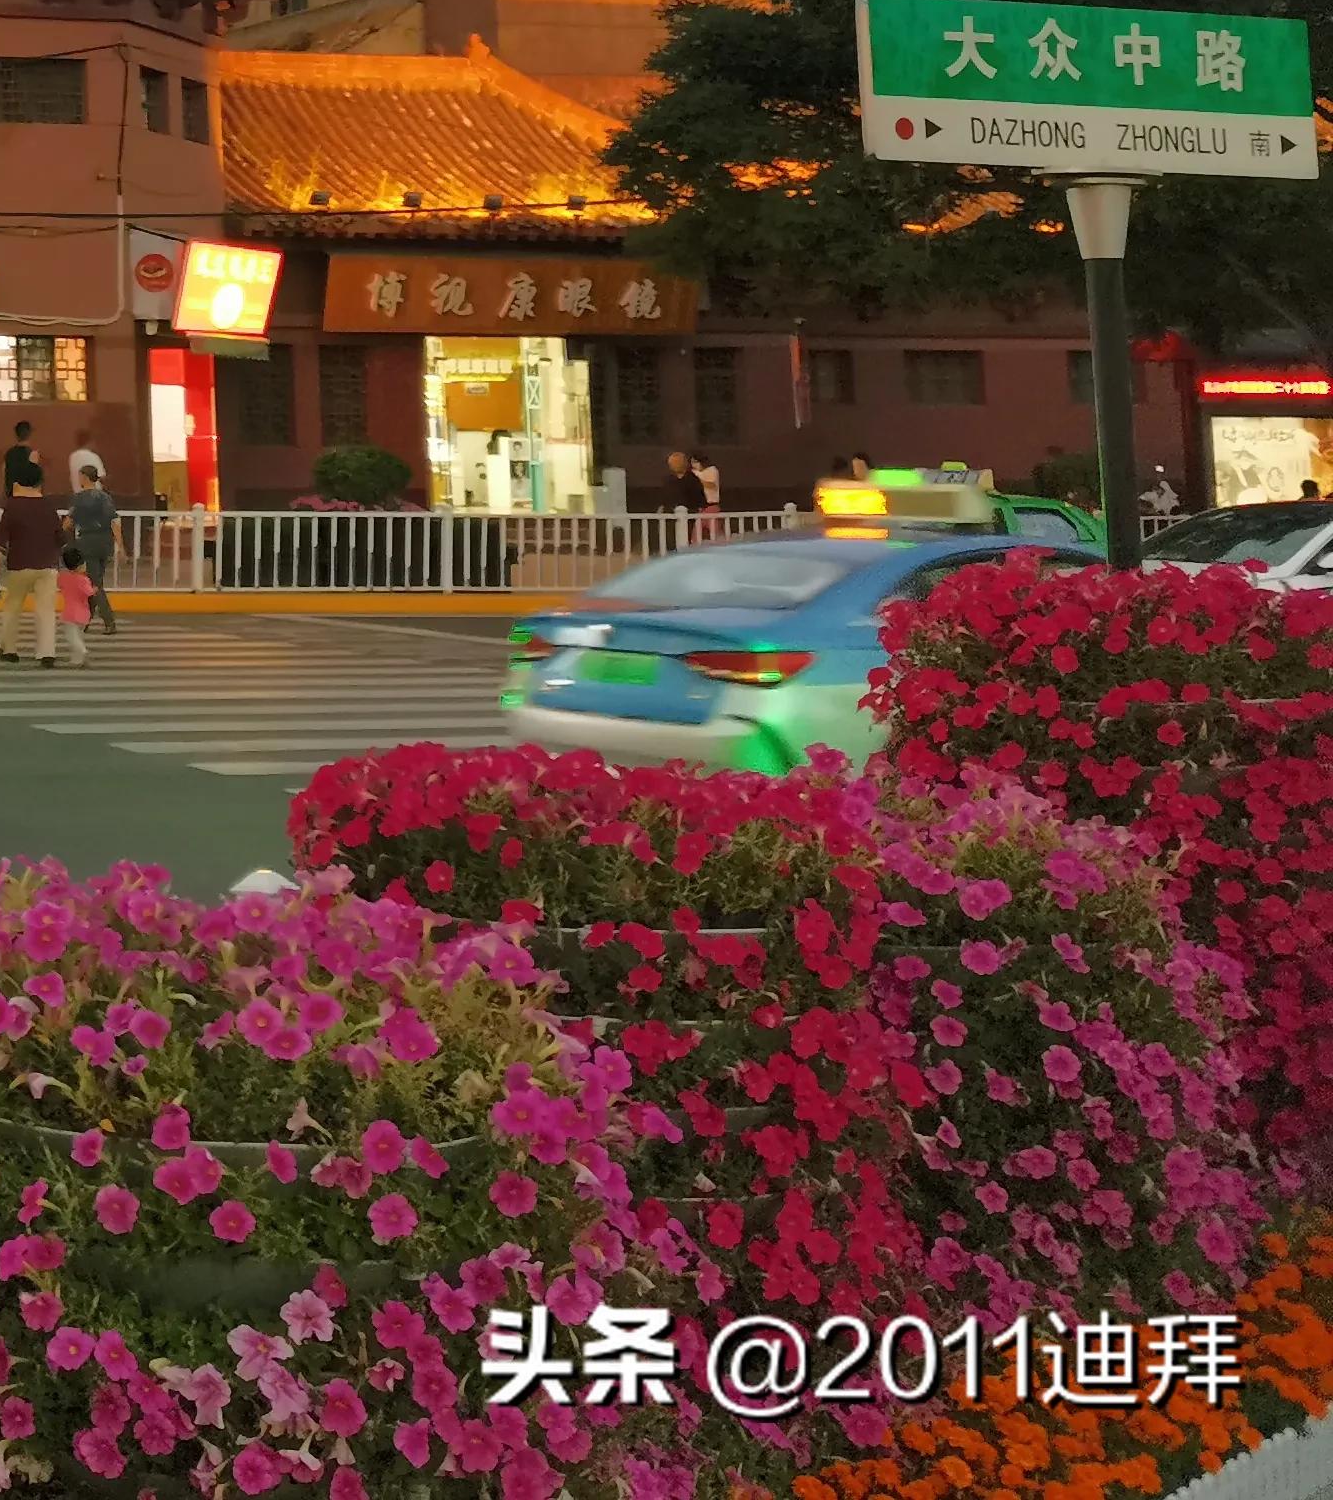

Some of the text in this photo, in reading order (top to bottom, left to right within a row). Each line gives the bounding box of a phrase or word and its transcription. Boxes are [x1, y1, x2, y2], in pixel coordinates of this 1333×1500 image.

[943, 15, 1246, 93] 大众中路
[970, 117, 1271, 157] DAZHONG ZHONGLU 南
